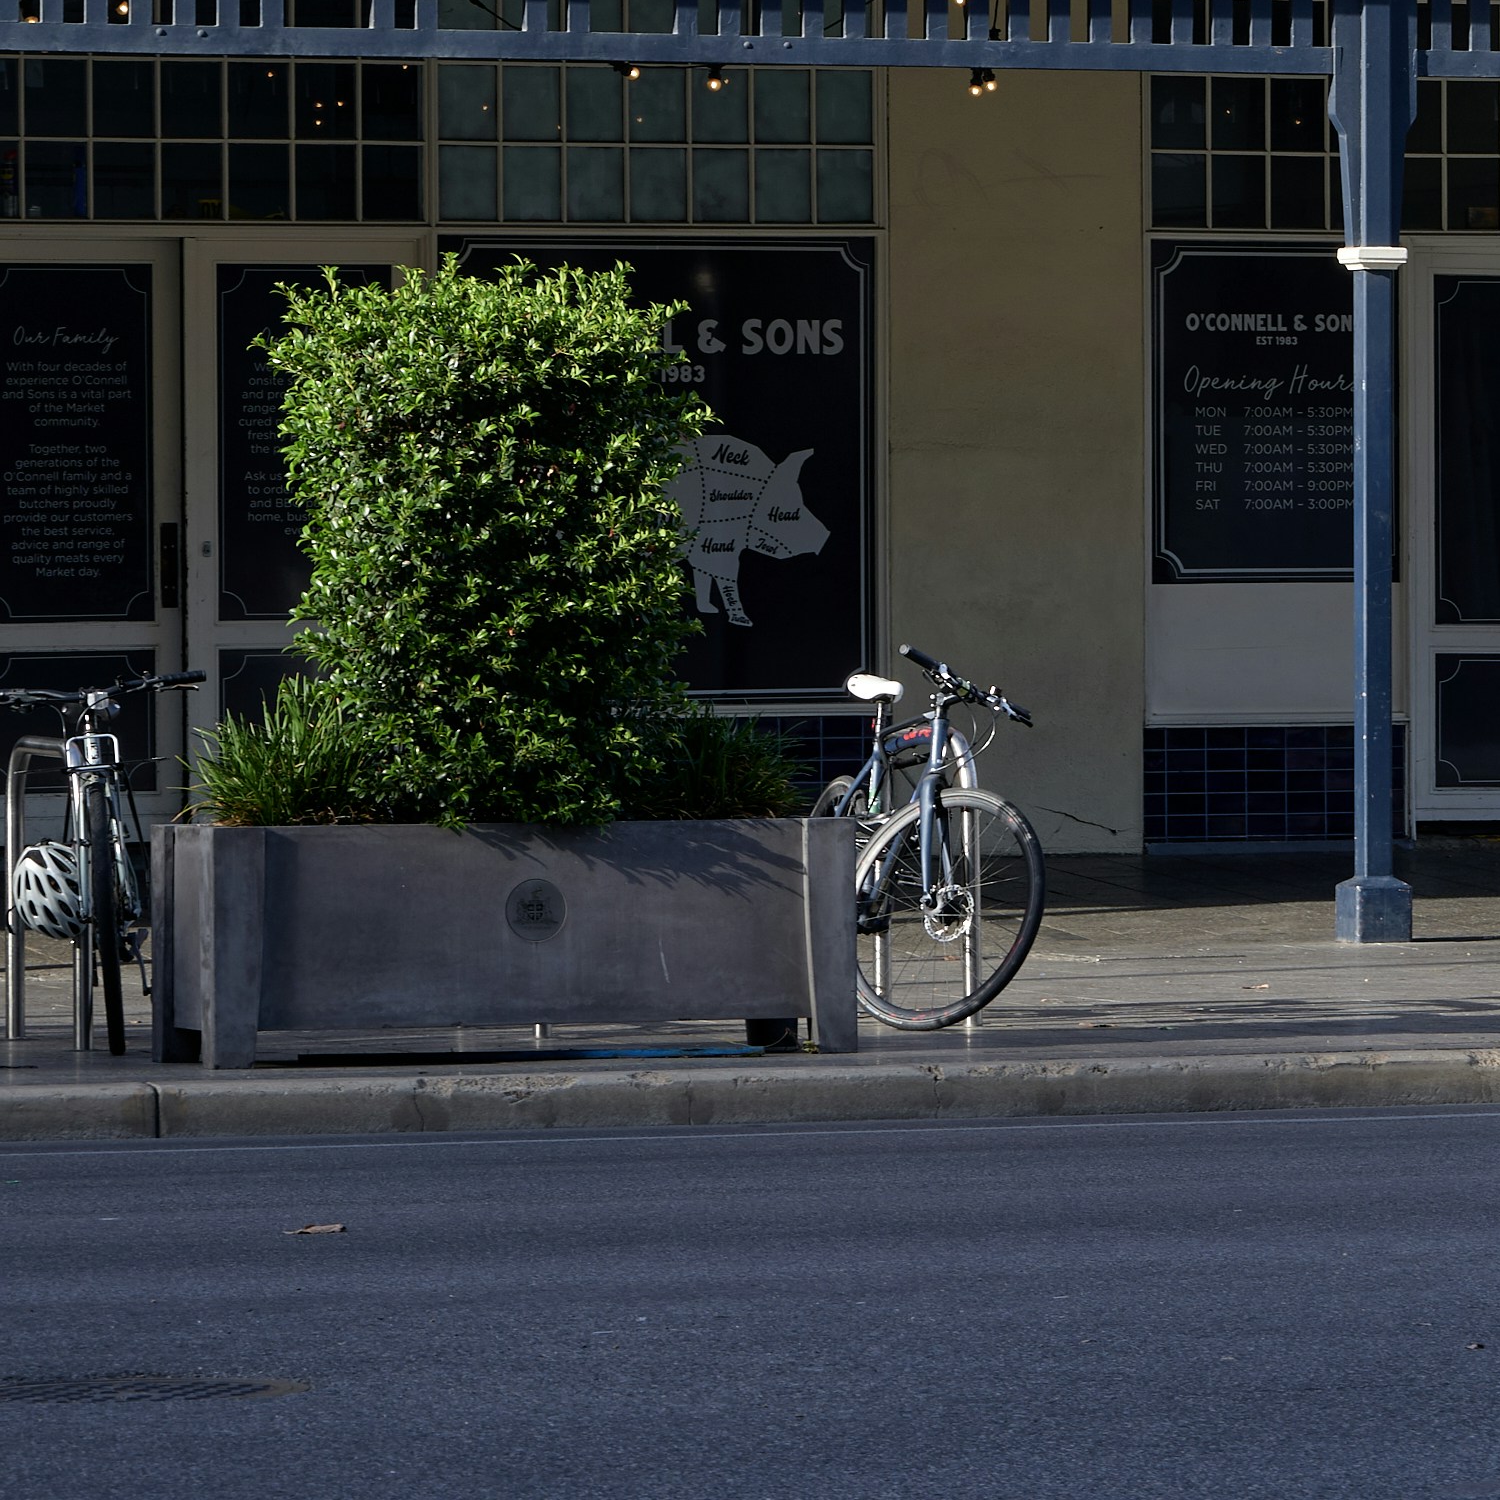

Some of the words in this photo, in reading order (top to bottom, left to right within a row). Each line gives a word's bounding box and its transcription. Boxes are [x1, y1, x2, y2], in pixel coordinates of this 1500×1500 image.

[1186, 313, 1287, 331] O'CONNELL
[1294, 315, 1307, 331] &
[1314, 313, 1352, 333] SON
[14, 326, 50, 345] Our
[53, 327, 119, 354] Family
[698, 319, 726, 353] &
[742, 319, 843, 355] SONS
[1257, 336, 1273, 345] EST
[1276, 337, 1297, 345] 1983
[7, 363, 33, 371] With
[38, 362, 60, 371] four
[64, 362, 111, 371] decades
[116, 361, 126, 371] of
[660, 365, 705, 383] 1983
[72, 376, 126, 384] O'Connell
[248, 377, 284, 385] onsite
[1184, 364, 1284, 400] Opening
[2, 390, 23, 399] and
[28, 389, 54, 398] Sons
[81, 390, 104, 398] vital
[109, 390, 131, 399] part
[242, 390, 264, 399] and
[30, 403, 40, 412] of
[45, 403, 62, 412] the
[67, 403, 104, 412] Market
[243, 405, 276, 414] range
[1195, 407, 1227, 418] MON
[1244, 407, 1293, 418] 7:00AM
[34, 418, 101, 427] community.
[239, 417, 271, 426] cured
[1195, 425, 1222, 436] TUE
[1244, 425, 1293, 436] 7:00AM
[29, 444, 80, 455] Together,
[85, 445, 106, 453] two
[251, 444, 270, 453] the
[1195, 444, 1227, 454] WED
[1244, 444, 1293, 454] 7:00AM
[711, 444, 750, 466] Neck
[16, 459, 82, 469] generations
[87, 457, 97, 466] of
[102, 458, 119, 466] the
[1195, 462, 1222, 473] THU
[1244, 462, 1293, 473] 7:00AM
[4, 472, 58, 481] O'Connell
[63, 471, 96, 482] family
[101, 471, 121, 480] and
[244, 472, 266, 481] Ask
[40, 485, 51, 494] of
[55, 485, 89, 496] highly
[94, 485, 128, 494] skilled
[248, 486, 260, 494] to
[1195, 481, 1216, 491] FRI
[1244, 481, 1293, 491] 7:00AM
[709, 489, 754, 502] Shoulder
[20, 499, 69, 508] butchers
[73, 499, 116, 509] proudly
[250, 499, 271, 507] and
[1195, 499, 1220, 510] SAT
[1244, 499, 1293, 510] 7:00AM
[4, 513, 47, 523] provide
[248, 513, 283, 521] home,
[768, 506, 800, 522] Head
[22, 527, 40, 535] the
[44, 527, 67, 535] best
[12, 541, 48, 549] advice
[53, 540, 73, 549] and
[78, 541, 110, 550] range
[114, 539, 125, 548] of
[701, 538, 735, 552] Hand
[13, 554, 51, 564] quality
[55, 554, 89, 562] meats
[93, 555, 124, 563] every
[36, 568, 75, 576] Market
[79, 567, 100, 577] day.
